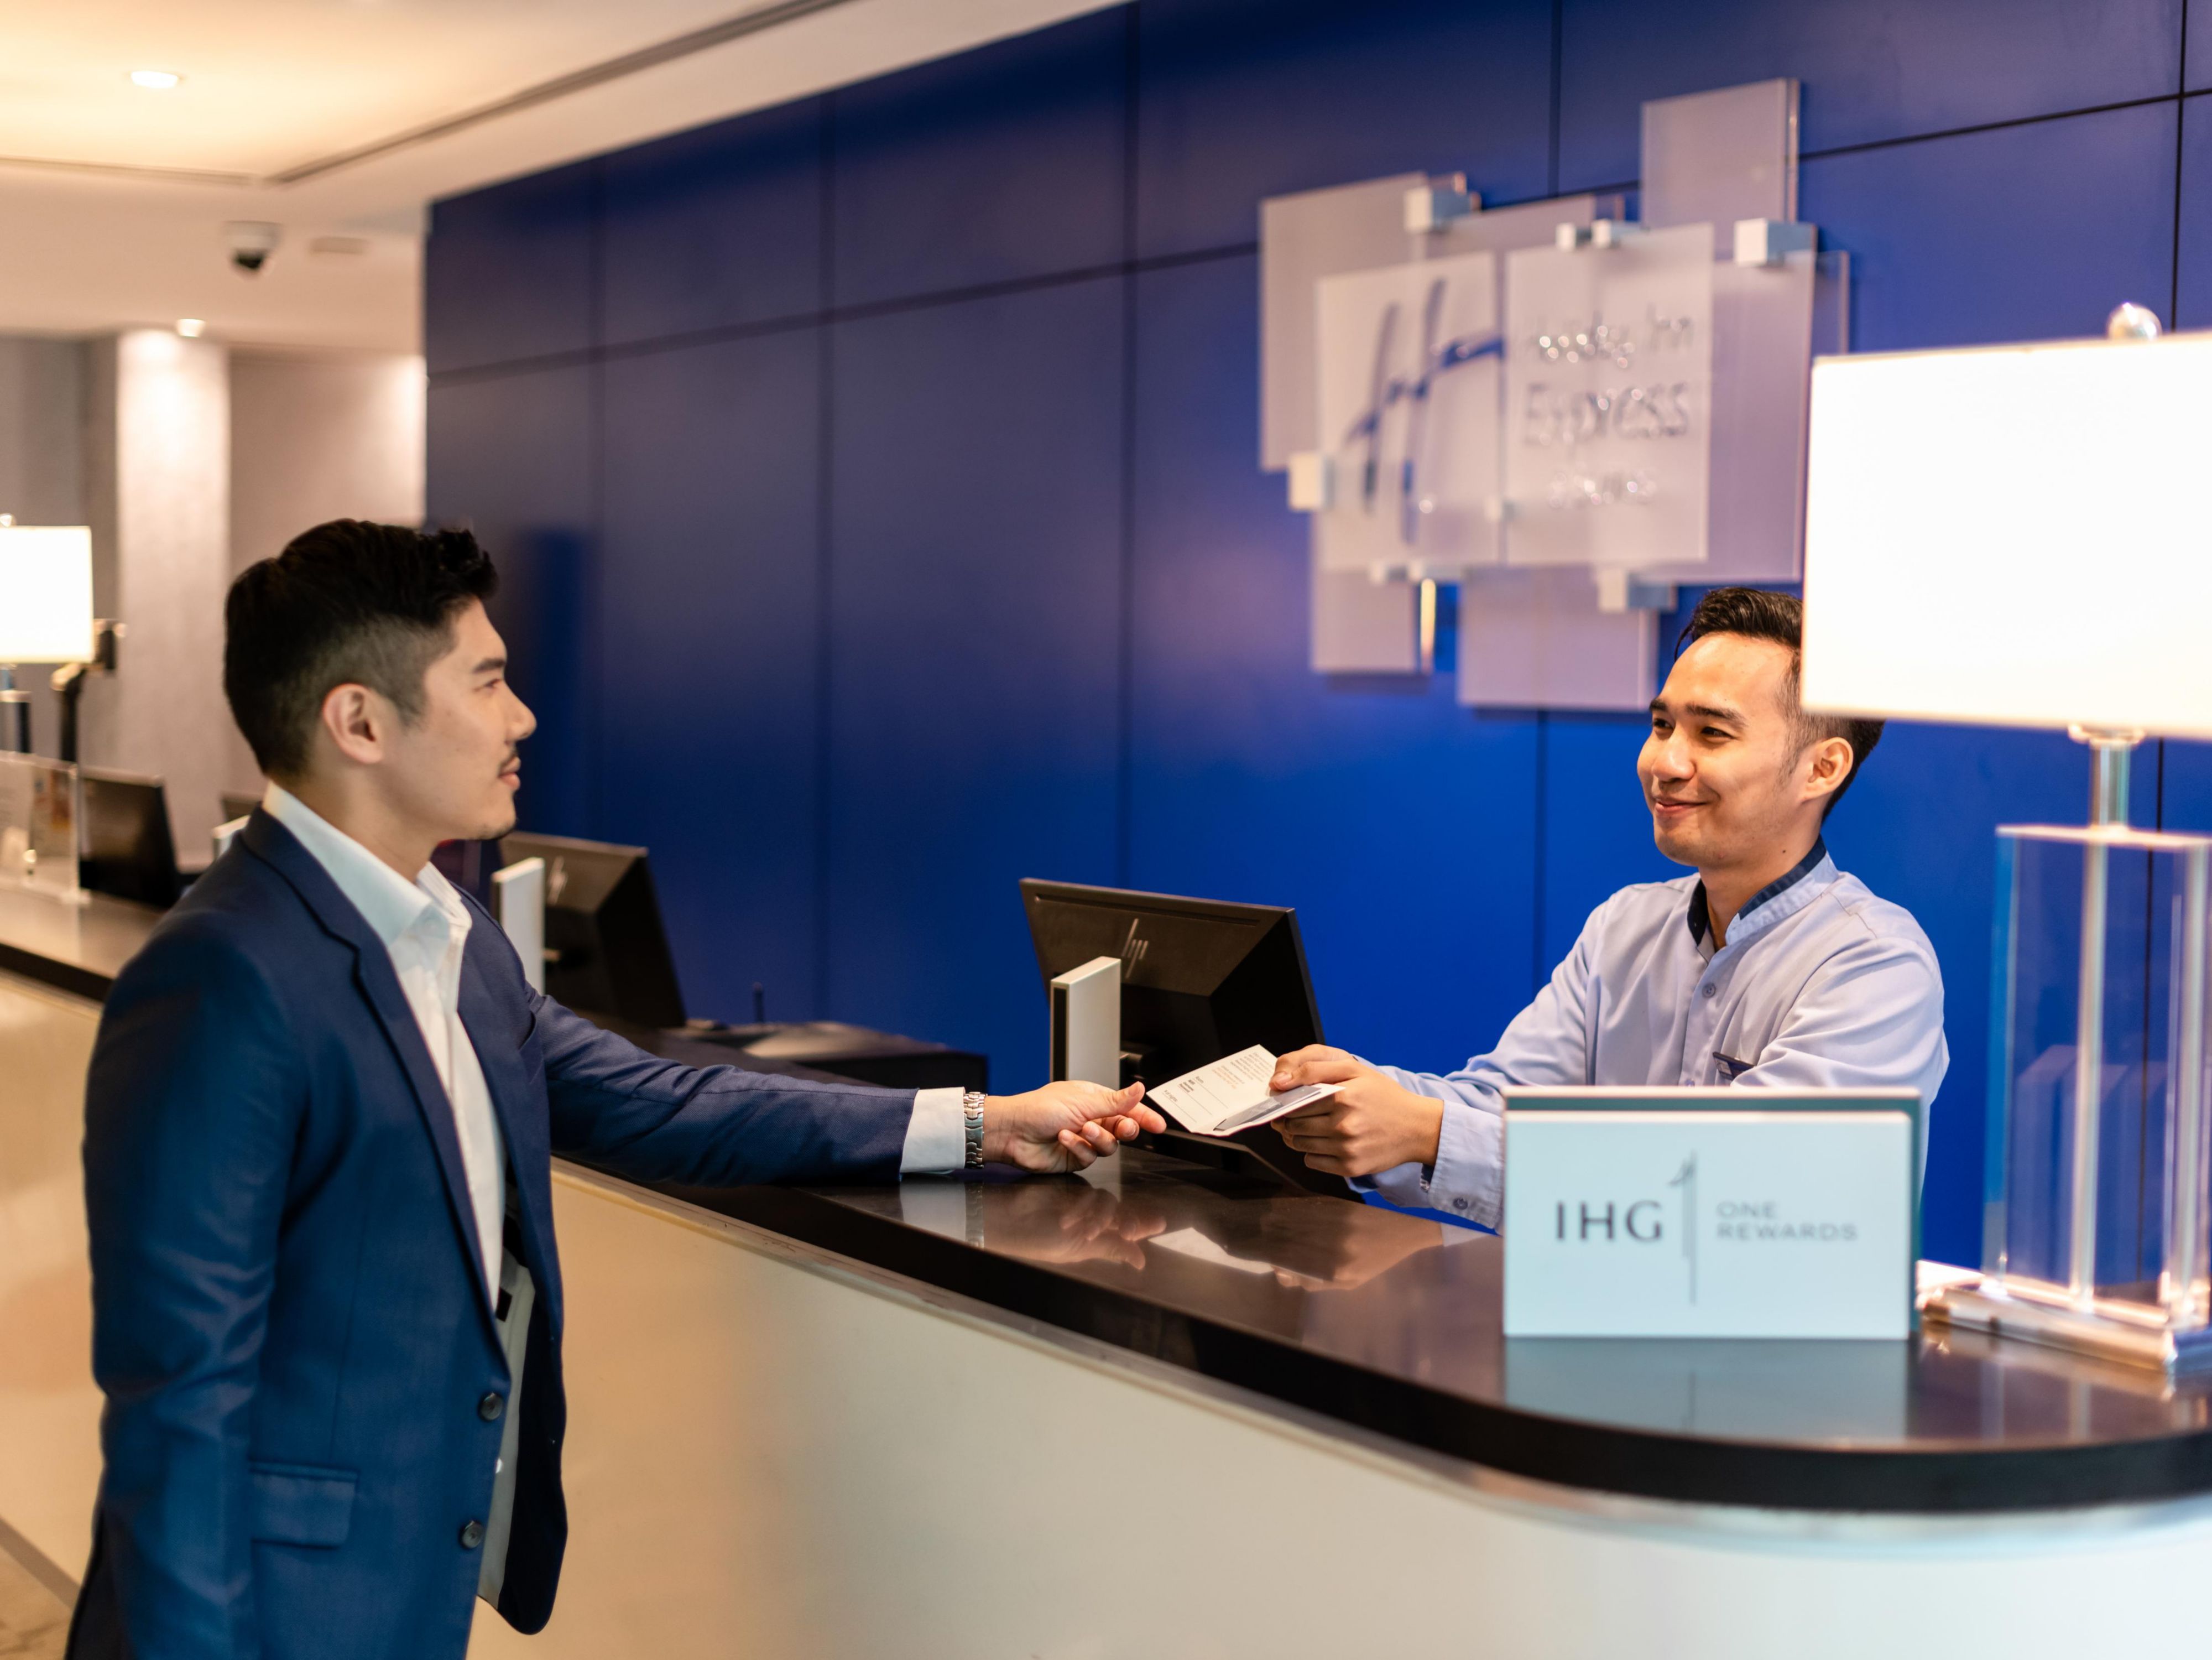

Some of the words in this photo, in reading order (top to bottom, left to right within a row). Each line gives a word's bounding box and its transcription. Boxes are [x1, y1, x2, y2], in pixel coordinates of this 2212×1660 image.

[1716, 1201, 1777, 1219] ONE
[1556, 1199, 1662, 1243] IHG
[1716, 1222, 1858, 1242] REWARDS
